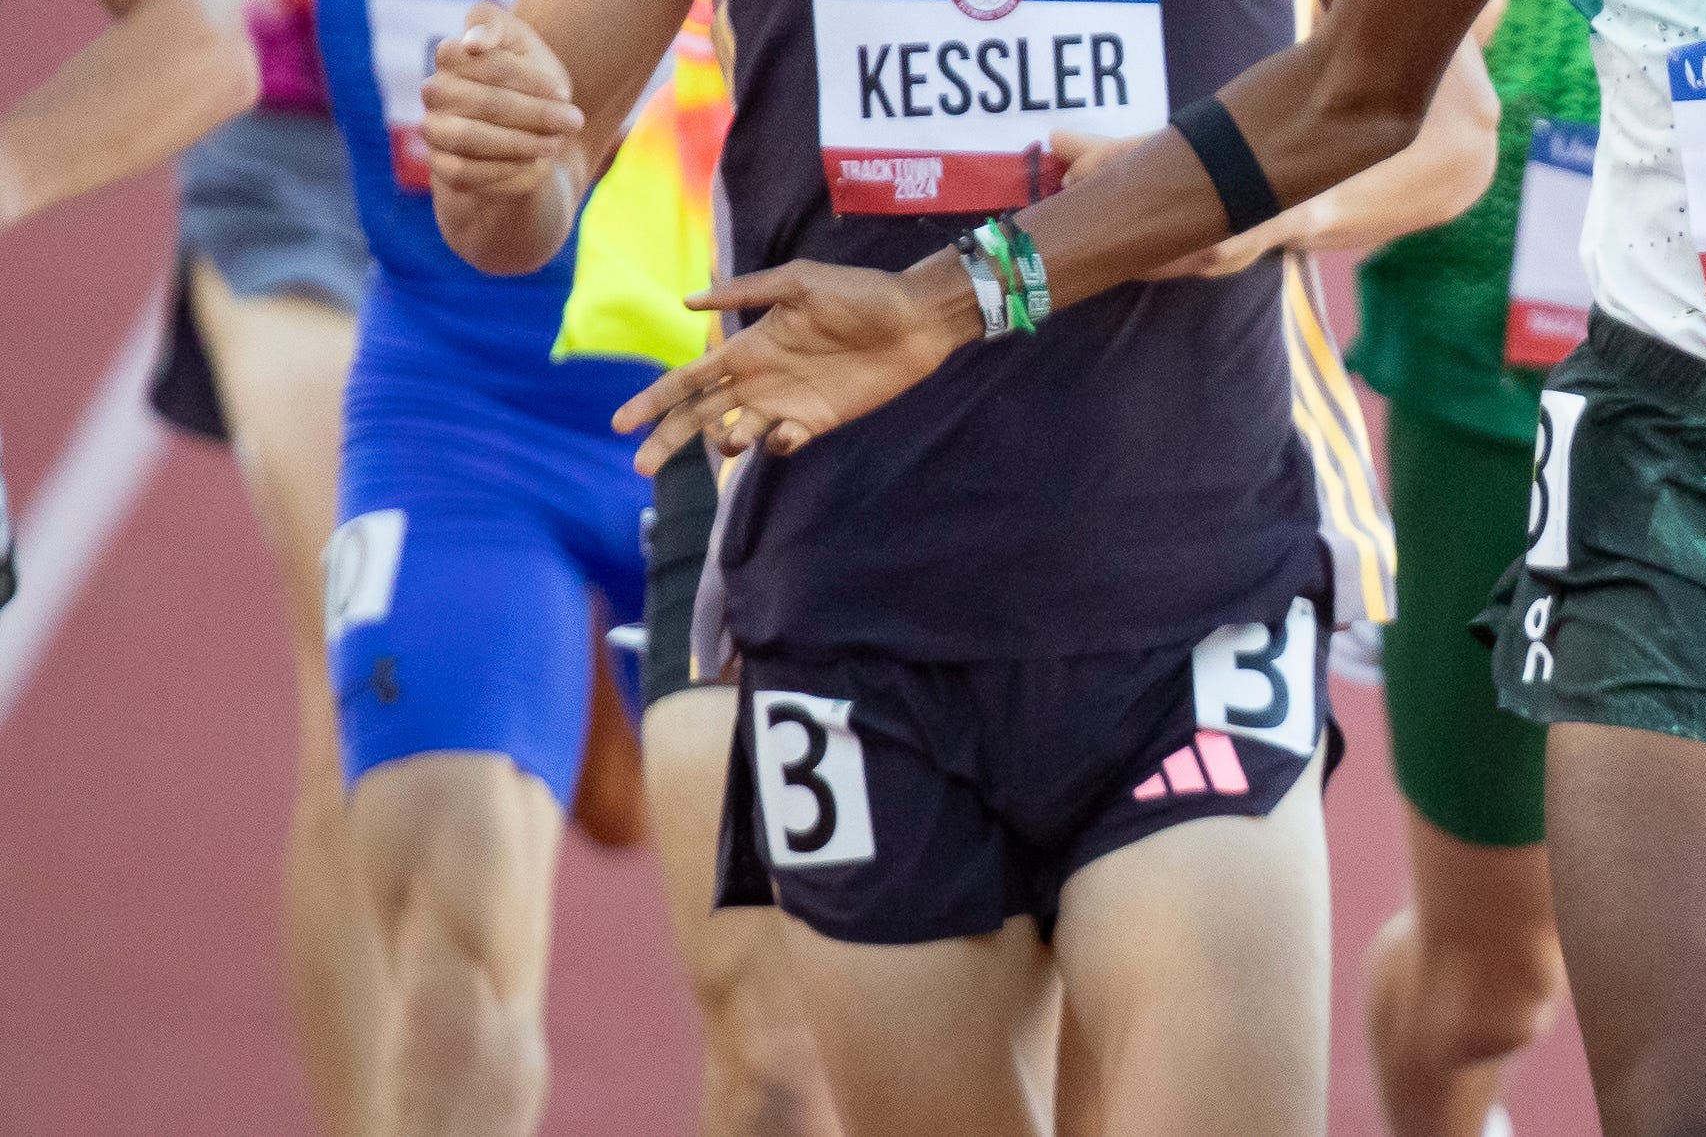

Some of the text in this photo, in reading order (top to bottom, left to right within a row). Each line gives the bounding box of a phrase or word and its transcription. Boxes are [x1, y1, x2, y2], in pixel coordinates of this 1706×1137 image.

[857, 32, 1129, 119] KESSLER
[1224, 619, 1289, 729] 3
[767, 700, 837, 853] 3
